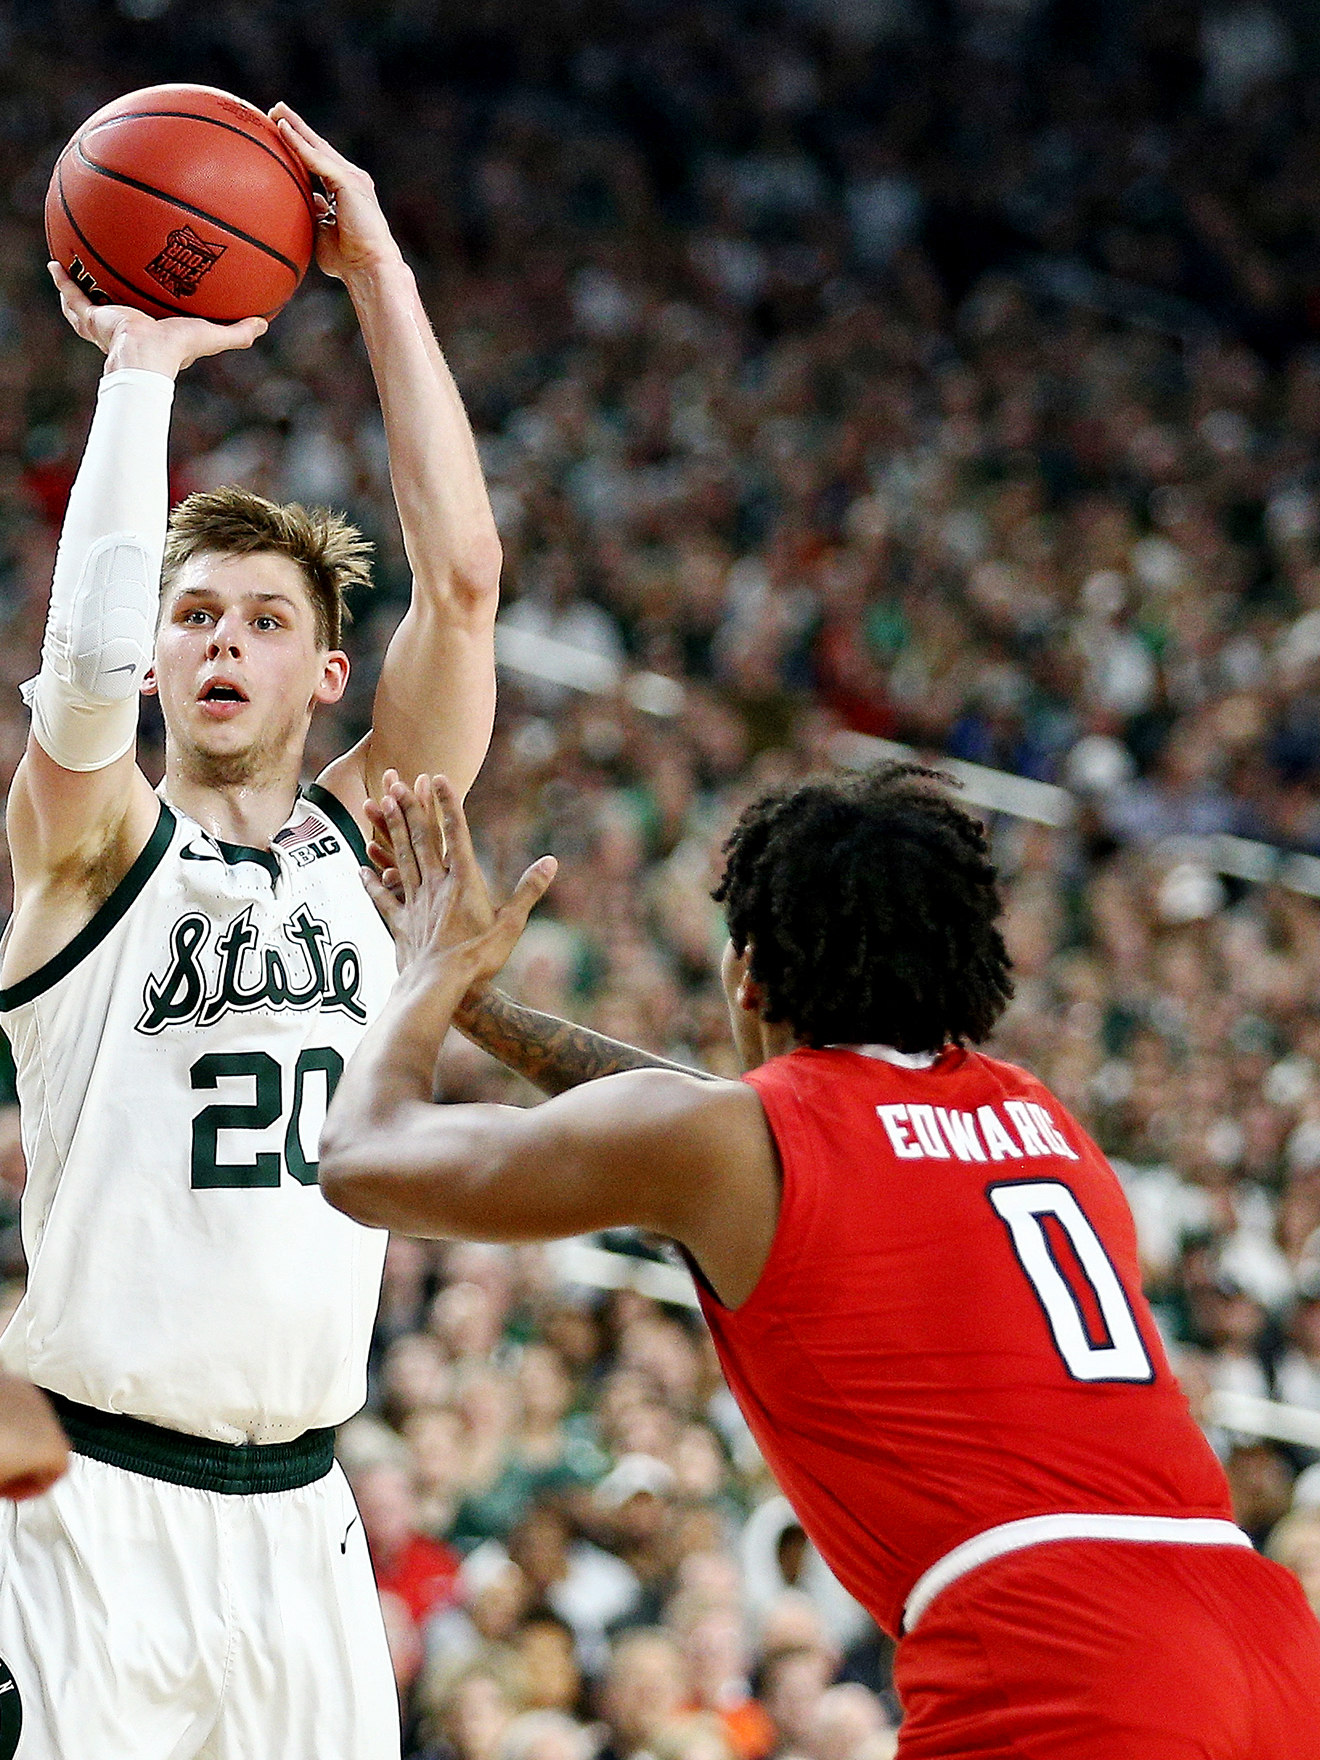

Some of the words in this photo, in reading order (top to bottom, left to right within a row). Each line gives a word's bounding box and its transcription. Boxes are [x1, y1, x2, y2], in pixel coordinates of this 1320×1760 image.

[157, 253, 202, 283] FINAL
[166, 241, 212, 274] FOUR
[135, 903, 367, 1035] State
[190, 1046, 345, 1190] 20
[985, 1177, 1156, 1384] 0
